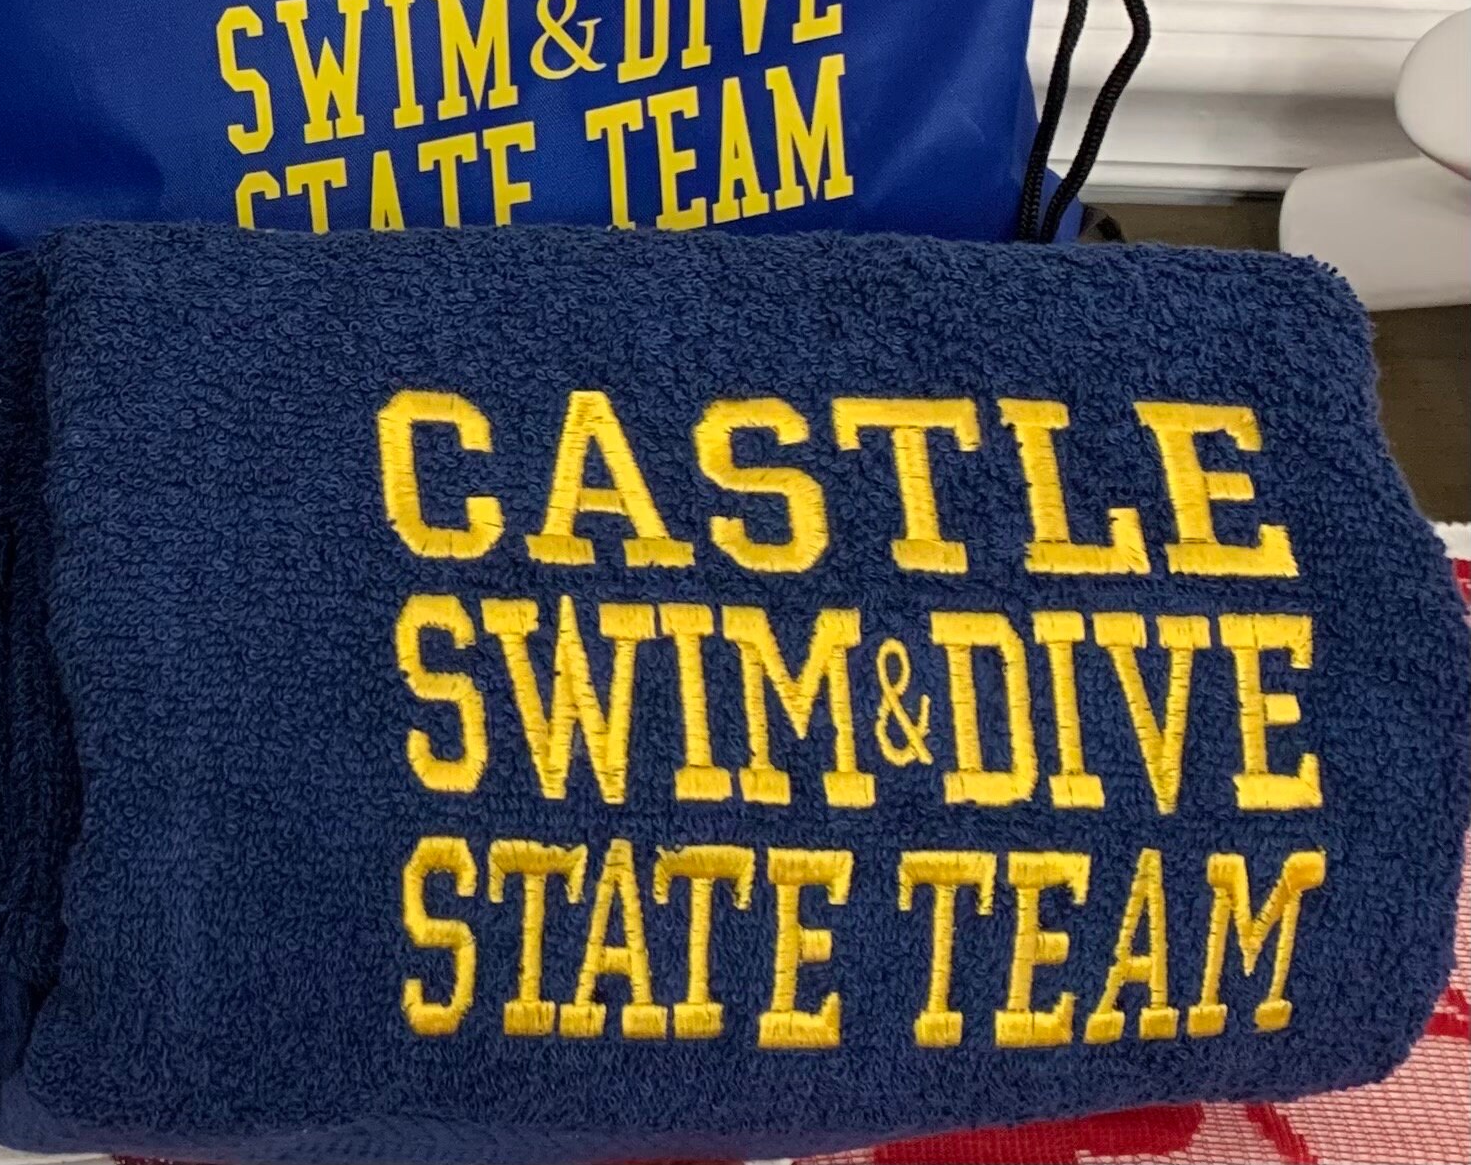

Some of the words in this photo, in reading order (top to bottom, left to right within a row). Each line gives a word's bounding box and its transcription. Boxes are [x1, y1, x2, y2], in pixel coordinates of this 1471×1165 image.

[585, 54, 853, 232] TEAM
[376, 389, 1299, 579] CASTLE
[394, 594, 868, 810] SWIM
[874, 638, 932, 768] &
[930, 610, 1323, 814] DIVE
[400, 836, 854, 1048] STATE
[898, 848, 1327, 1048] TEAM
